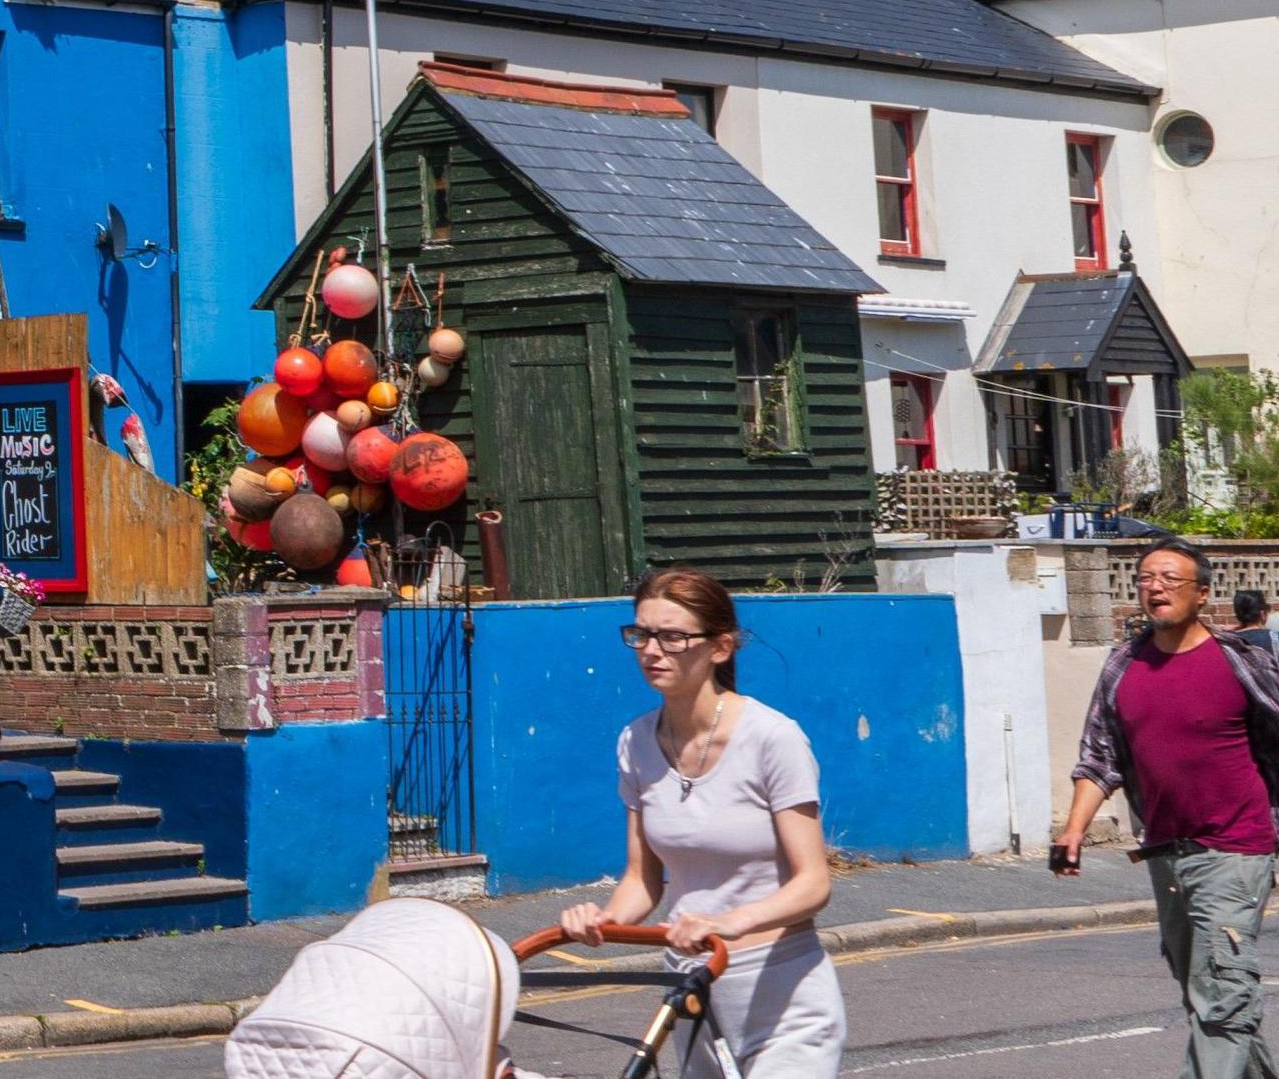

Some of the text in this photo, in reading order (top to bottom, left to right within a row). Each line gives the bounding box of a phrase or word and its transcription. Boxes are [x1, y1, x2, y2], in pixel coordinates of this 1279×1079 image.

[1, 407, 47, 434] LIVE
[5, 459, 45, 481] Saturday
[5, 529, 53, 557] Rider
